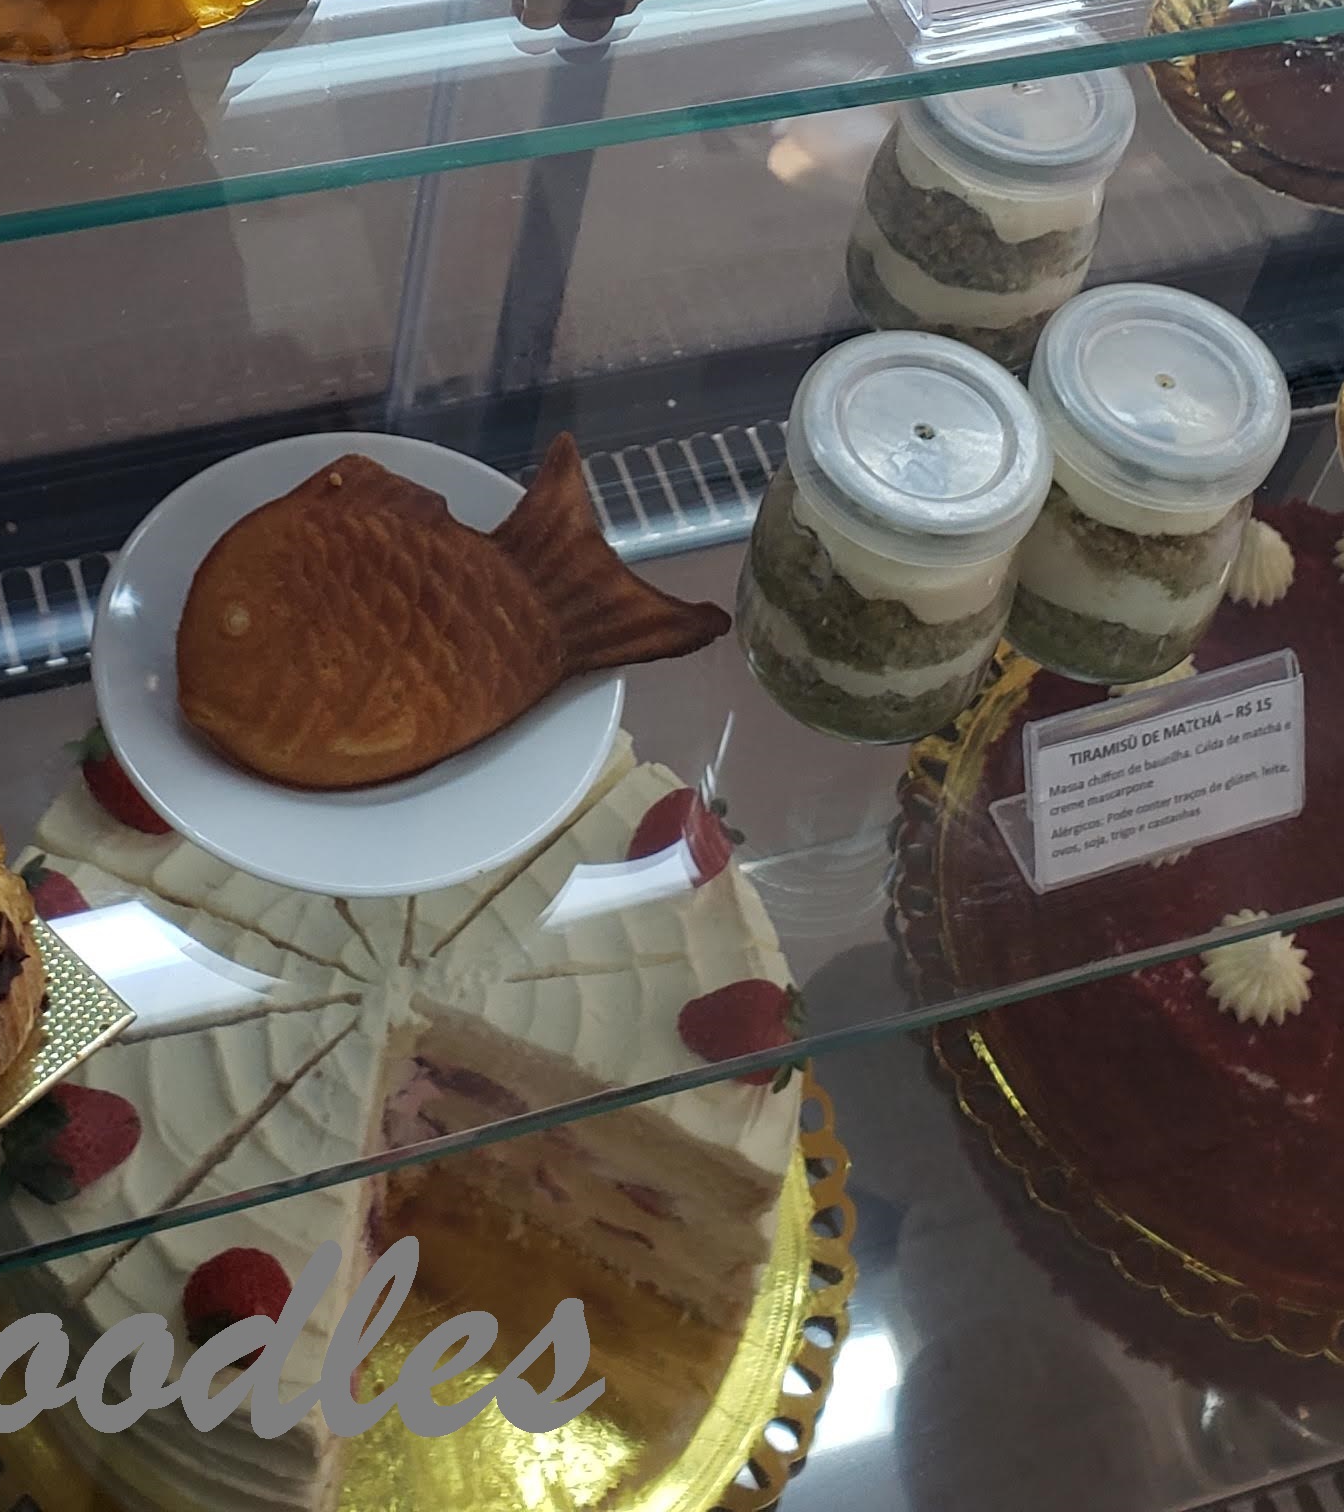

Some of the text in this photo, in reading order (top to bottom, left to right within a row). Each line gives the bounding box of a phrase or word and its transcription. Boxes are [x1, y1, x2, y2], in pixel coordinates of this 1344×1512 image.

[1142, 730, 1160, 747] DE
[1236, 702, 1252, 718] R$
[1256, 698, 1271, 712] 15
